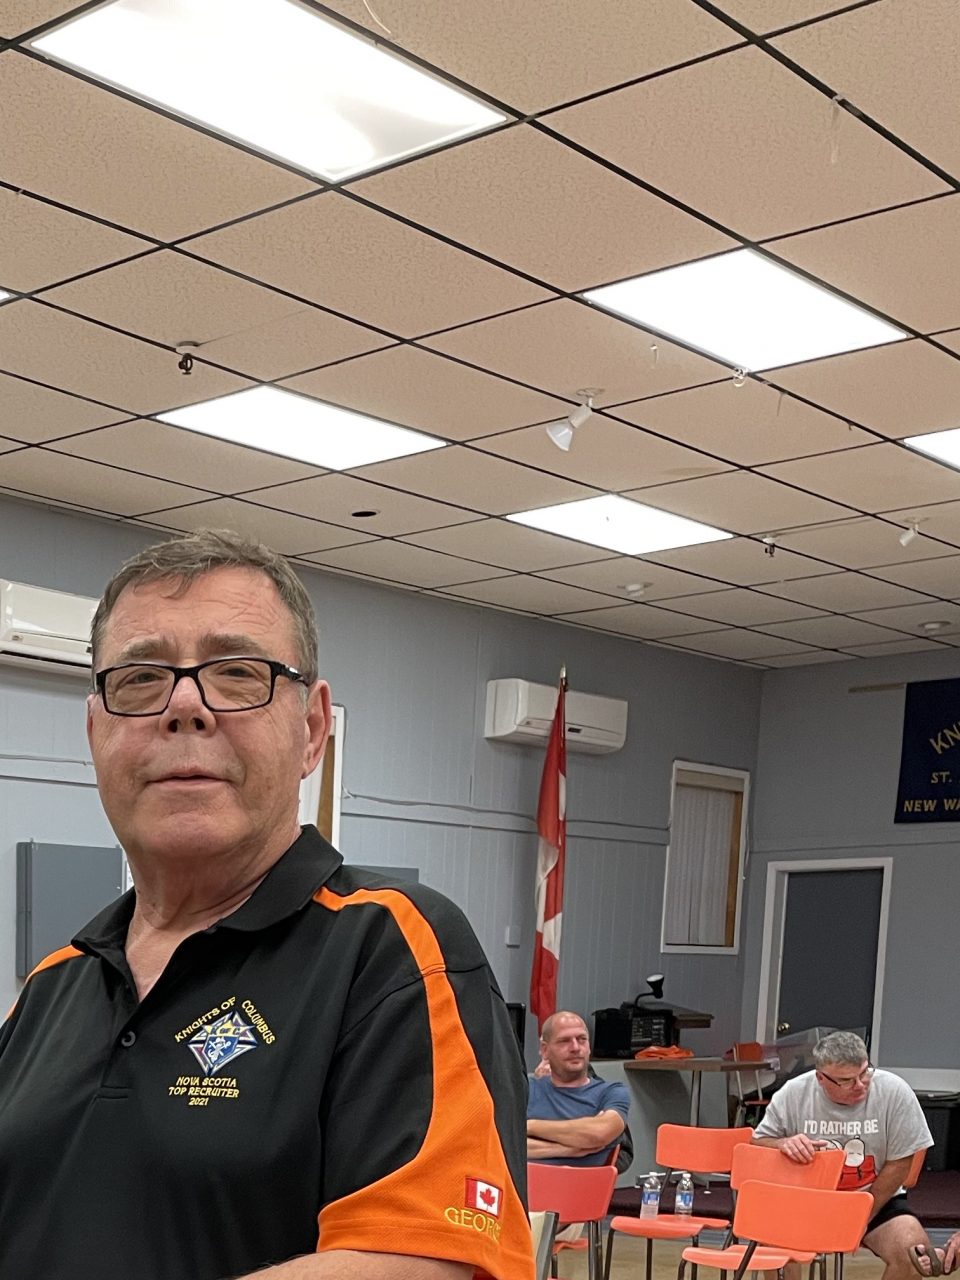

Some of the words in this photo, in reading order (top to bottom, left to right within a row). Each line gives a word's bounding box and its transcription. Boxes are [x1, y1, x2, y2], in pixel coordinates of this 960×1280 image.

[930, 771, 952, 784] ST.
[903, 800, 937, 813] NEW
[174, 1007, 220, 1043] KNIGHTS
[220, 996, 236, 1011] OF
[241, 1000, 276, 1044] COLUMBUS
[176, 1076, 200, 1086] NOVA
[202, 1077, 237, 1088] SCOTIA
[168, 1086, 187, 1096] TOP
[188, 1087, 240, 1098] RECRUITER
[188, 1097, 209, 1106] 2021
[803, 1119, 818, 1135] I'D
[820, 1120, 862, 1136] RATHER
[863, 1119, 879, 1134] BE
